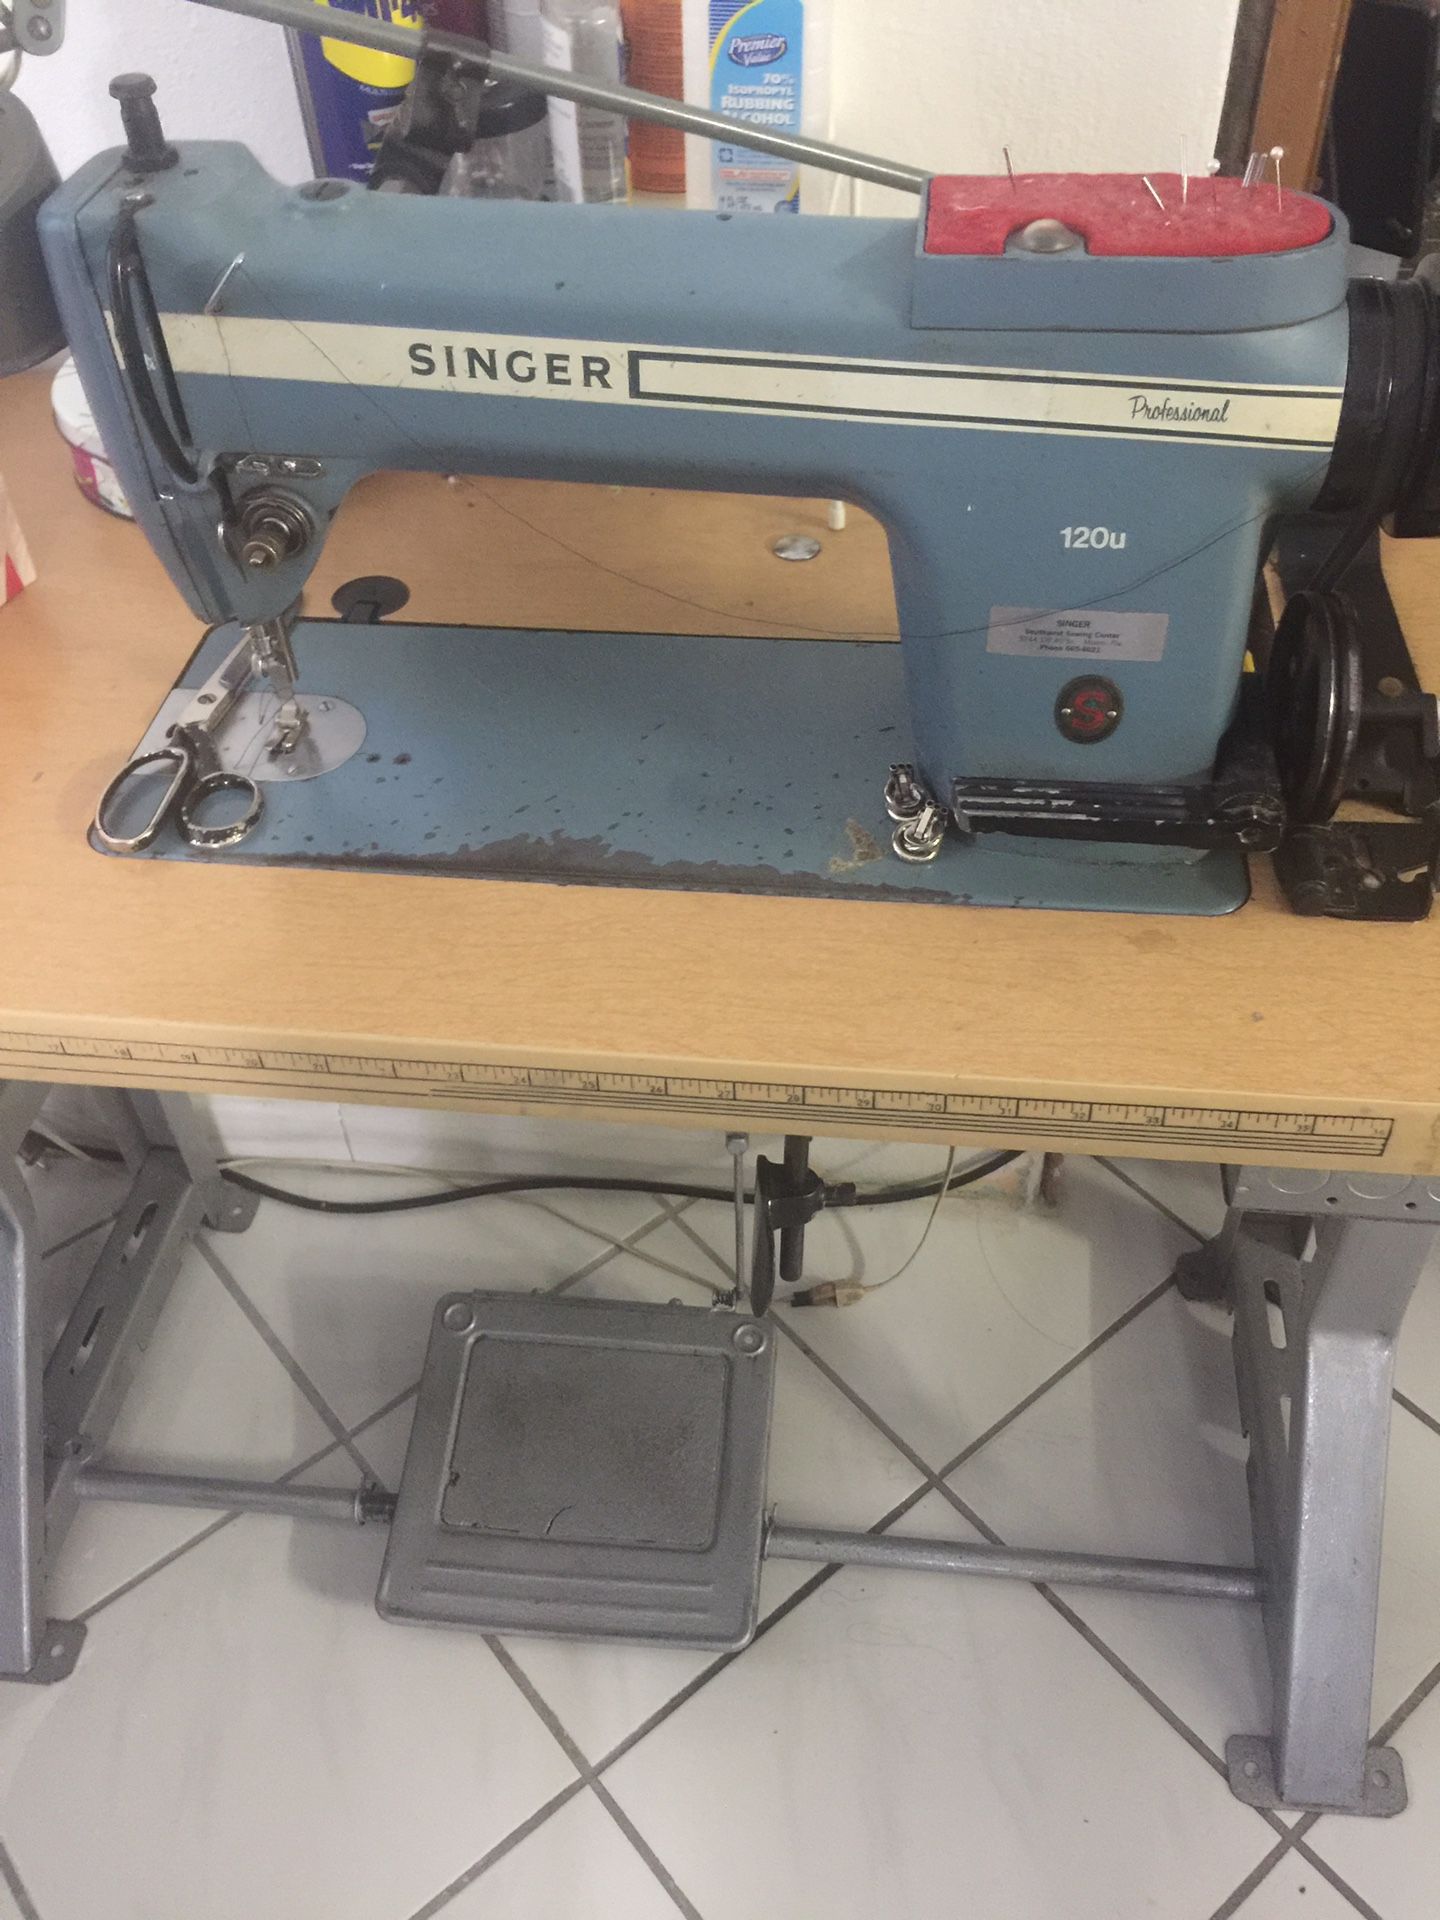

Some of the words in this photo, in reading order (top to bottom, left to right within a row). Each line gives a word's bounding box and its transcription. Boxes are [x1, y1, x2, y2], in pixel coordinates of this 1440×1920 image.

[729, 35, 786, 54] Premier
[743, 51, 772, 67] Value
[763, 73, 794, 85] 70%
[727, 84, 795, 96] ISOPROPYL
[721, 96, 795, 110] RUBBING
[721, 110, 795, 125] COHOL
[408, 343, 613, 389] SINGER
[1128, 395, 1231, 423] Professional
[1060, 527, 1127, 549] 120u
[1056, 619, 1091, 629] SINGER
[1094, 631, 1120, 639] Center
[582, 1080, 595, 1089] 25
[650, 1085, 663, 1094] 26
[718, 1090, 731, 1099] 27
[857, 1098, 870, 1107] 29
[1145, 1116, 1160, 1125] 33
[1220, 1120, 1233, 1129] 34
